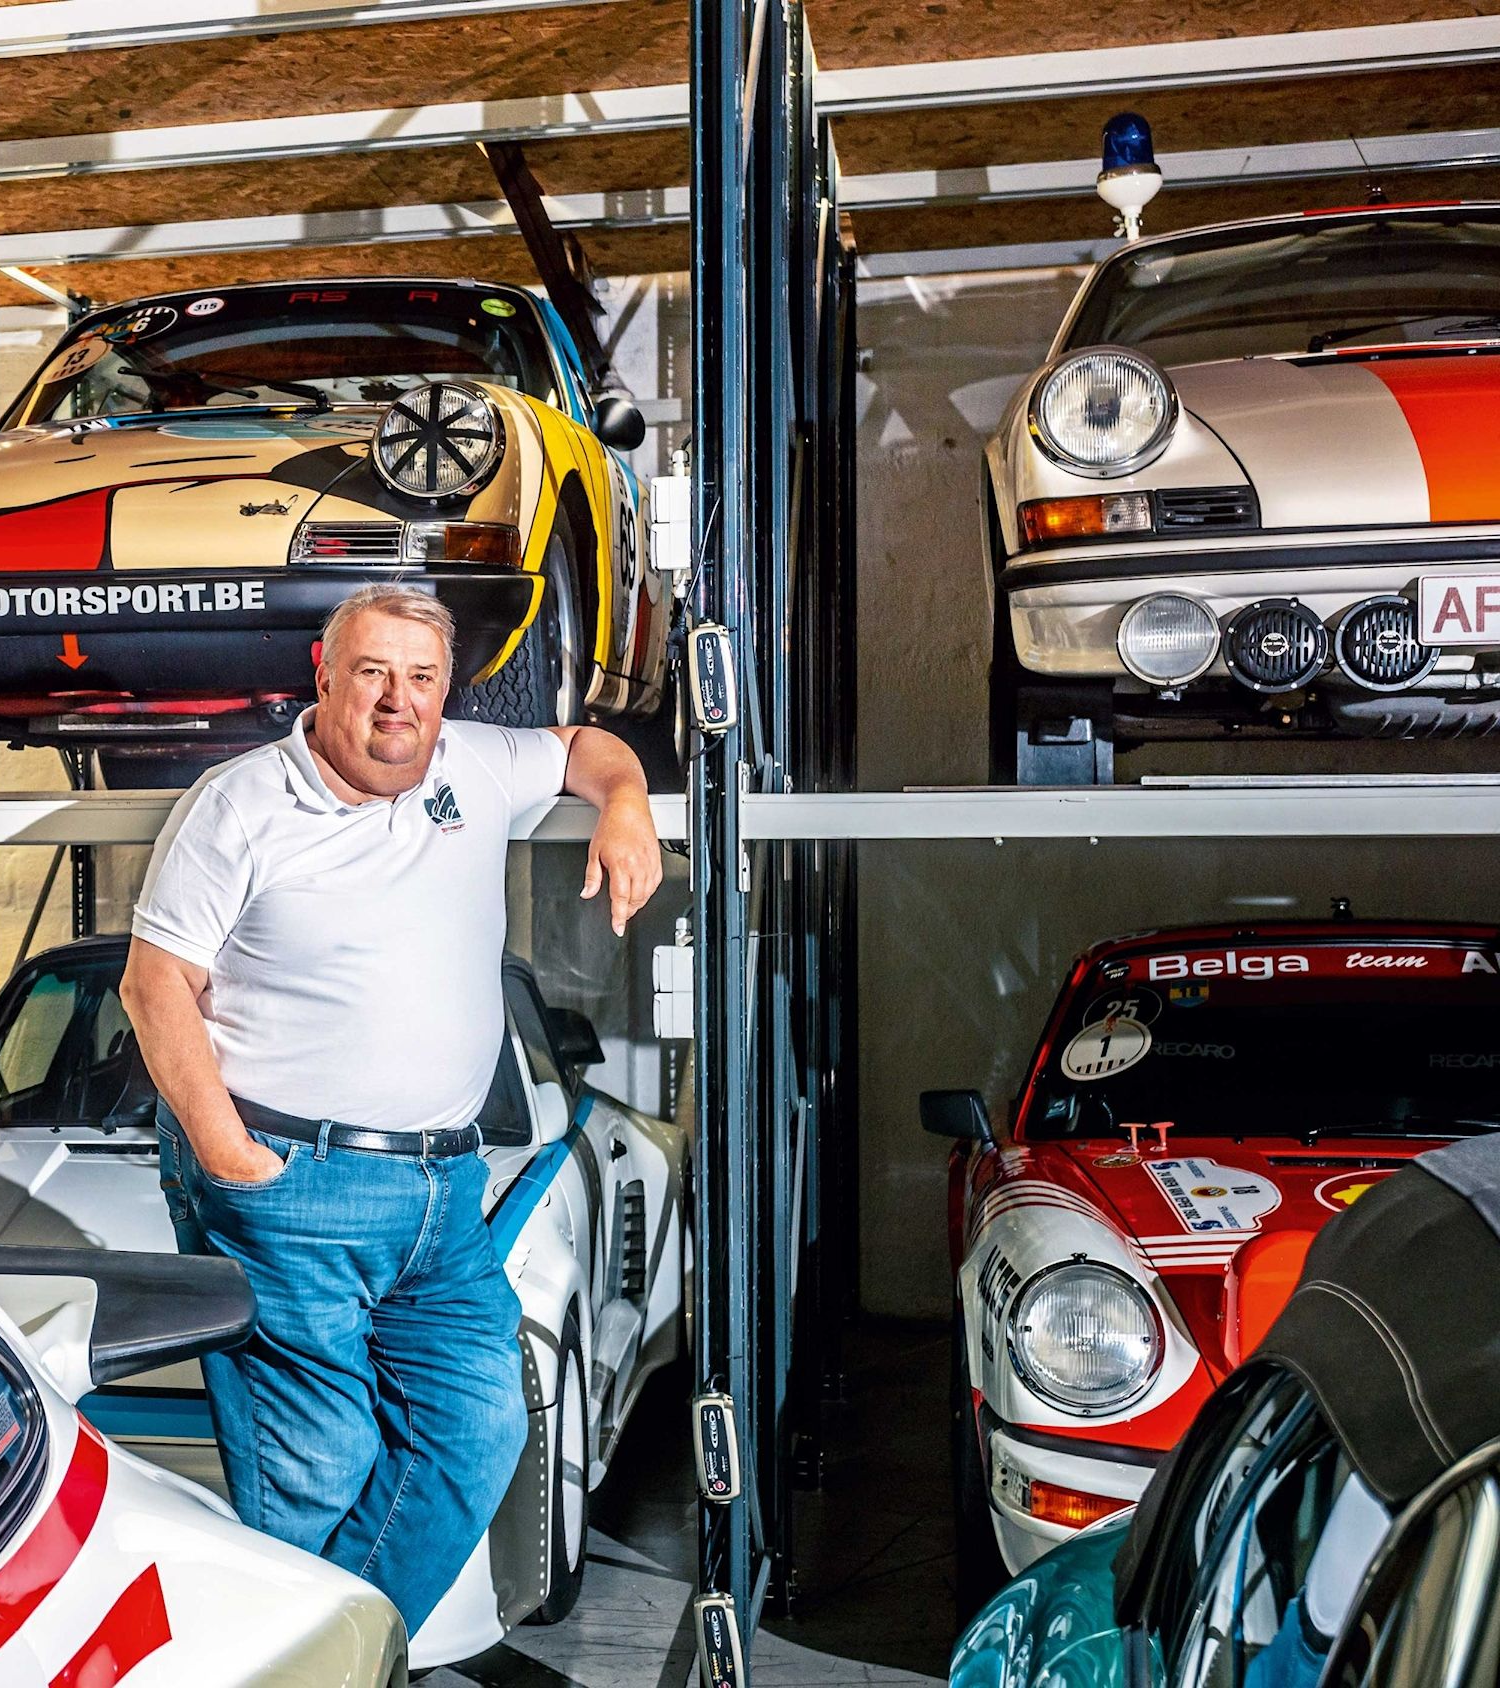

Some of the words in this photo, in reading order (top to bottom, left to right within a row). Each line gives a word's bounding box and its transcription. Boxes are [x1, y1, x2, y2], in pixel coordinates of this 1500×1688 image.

[193, 302, 217, 312] 315
[64, 348, 90, 367] 13
[619, 500, 636, 591] 69
[1432, 586, 1500, 633] AF
[1149, 951, 1309, 980] Belga
[1346, 951, 1429, 969] team
[1106, 1000, 1140, 1019] 25
[1100, 1035, 1111, 1058] 1
[1151, 1042, 1235, 1059] RECARO
[1231, 1185, 1260, 1195] 18
